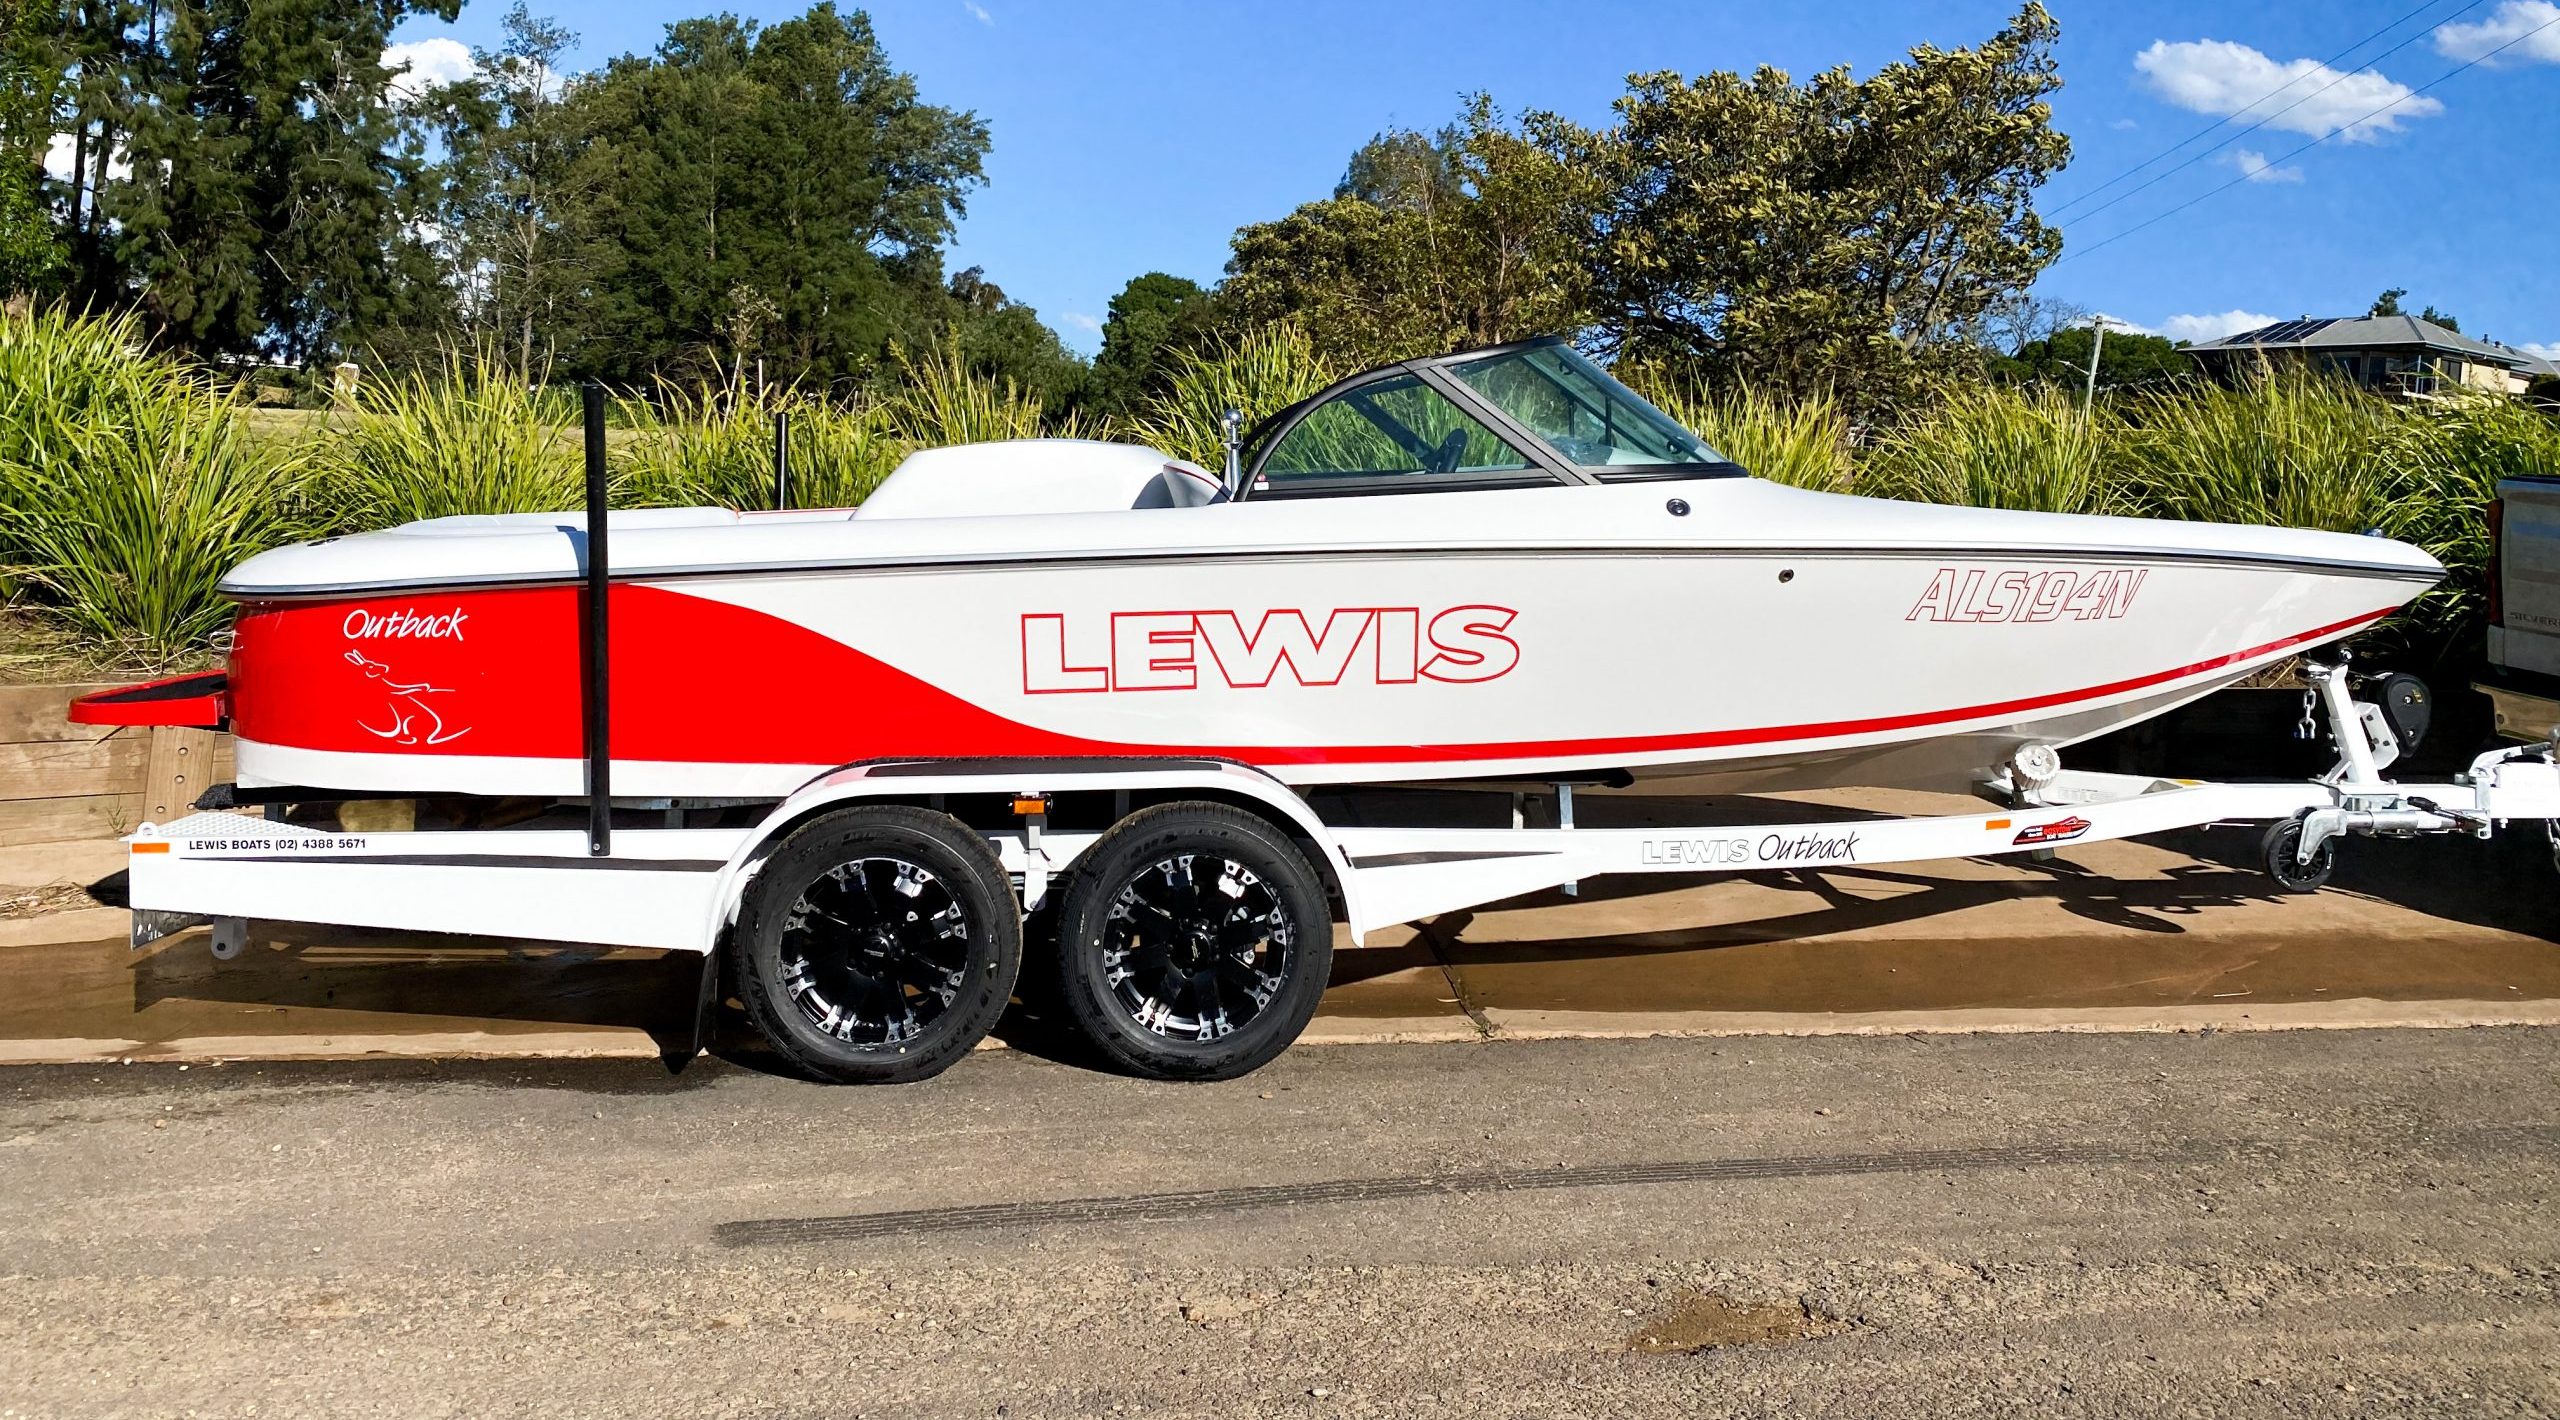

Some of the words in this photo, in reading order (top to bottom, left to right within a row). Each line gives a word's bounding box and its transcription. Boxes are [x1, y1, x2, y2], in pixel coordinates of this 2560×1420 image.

[1905, 569, 2149, 622] ALS194N
[343, 607, 468, 641] Outback
[1021, 605, 1520, 694] LEWIS
[189, 840, 227, 850] LEWIS
[232, 840, 271, 850] BOATS
[275, 839, 298, 851] (02)
[302, 839, 333, 849] 4388
[338, 839, 366, 849] 5671
[1642, 839, 1750, 864] LEWIS
[1758, 831, 1860, 861] Outback
